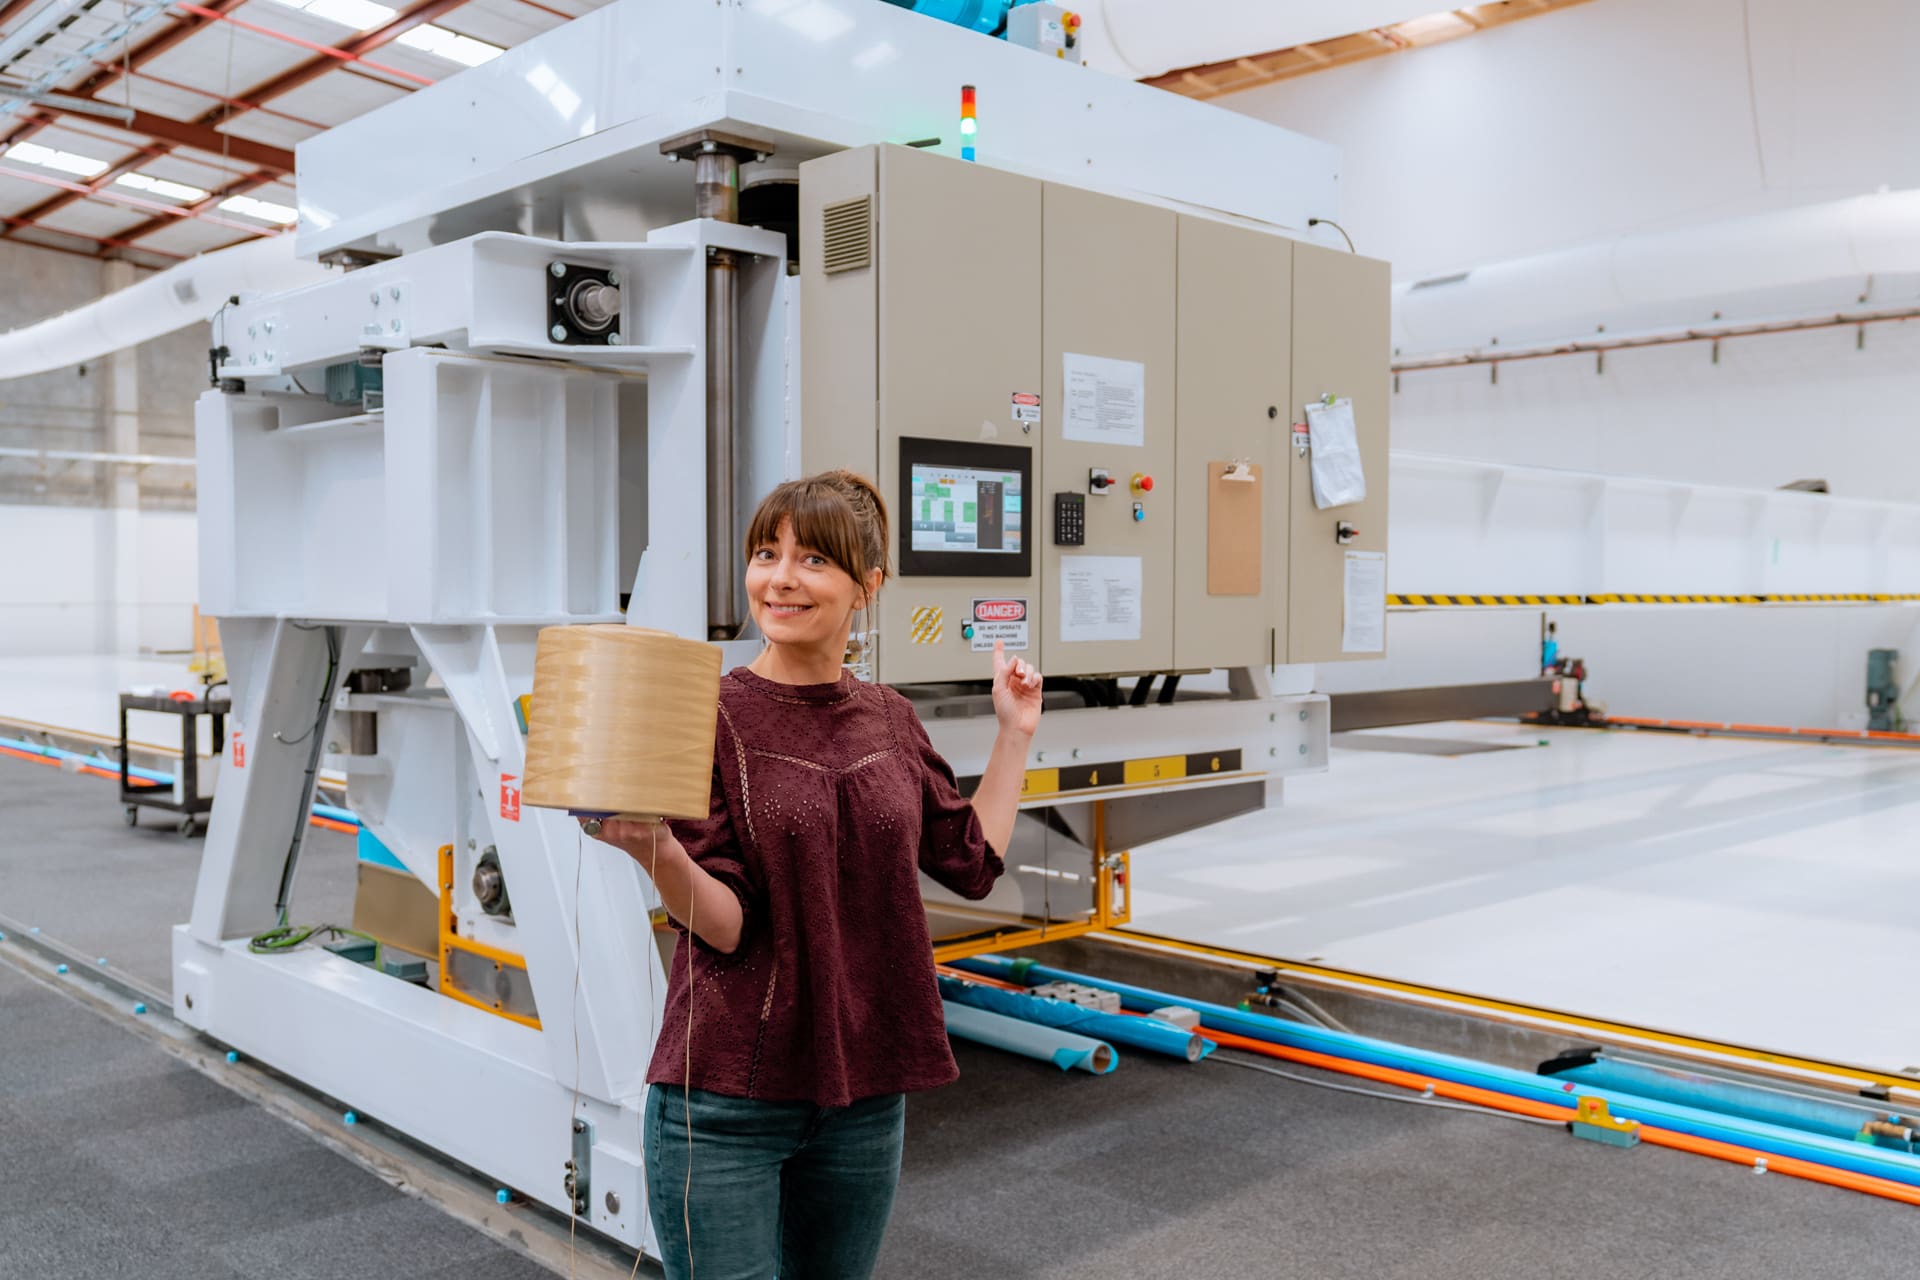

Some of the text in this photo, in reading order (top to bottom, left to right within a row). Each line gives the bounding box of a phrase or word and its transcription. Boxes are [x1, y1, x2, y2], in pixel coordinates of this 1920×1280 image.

[979, 605, 1021, 617] DANGER
[1021, 756, 1220, 792] 3 4 5 6
